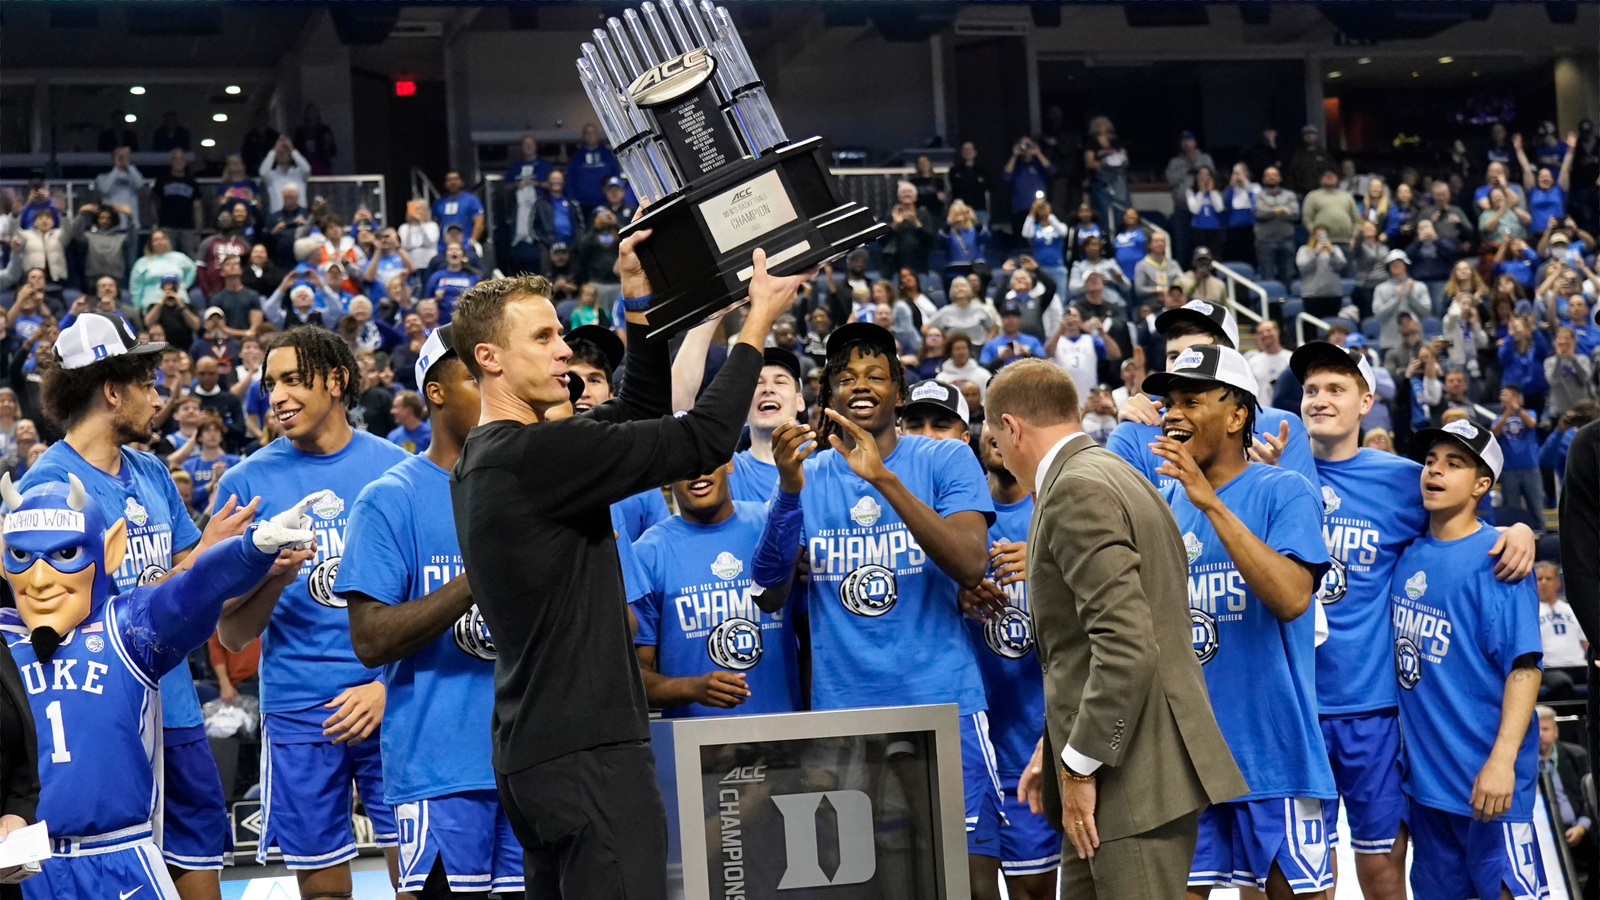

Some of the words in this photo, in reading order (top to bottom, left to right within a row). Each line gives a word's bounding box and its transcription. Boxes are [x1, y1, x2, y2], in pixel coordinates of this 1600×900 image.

[632, 45, 708, 96] ACC
[722, 205, 739, 219] MEN'S
[739, 193, 768, 212] BASKETBALL
[730, 187, 753, 204] ACC
[730, 203, 771, 230] CHAMPION
[9, 512, 39, 530] WAHOO
[42, 509, 80, 528] WON'T
[819, 529, 835, 537] 2023
[837, 528, 850, 536] ACC
[853, 527, 873, 536] MEN'S
[875, 522, 907, 534] BASKETBA
[1330, 516, 1372, 528] BASKETBALL
[112, 531, 172, 579] HAMP
[809, 530, 926, 574] CHAMPS
[1322, 524, 1380, 565] MPS
[431, 555, 449, 564] 2023
[1194, 560, 1235, 574] BASKETBALL
[897, 566, 923, 576] COLISEUM
[116, 577, 137, 587] ENSBORO
[681, 585, 697, 595] 2023
[700, 583, 713, 591] ACC
[715, 580, 735, 589] MEN'S
[869, 579, 885, 596] D
[1187, 571, 1246, 614] MPS
[1415, 602, 1447, 618] BASKETBALL
[1391, 602, 1452, 657] AMPS
[736, 633, 753, 650] D
[21, 659, 109, 695] UKE
[46, 700, 72, 764] 1
[721, 764, 768, 782] ACC
[770, 789, 877, 890] D
[1302, 819, 1322, 845] D
